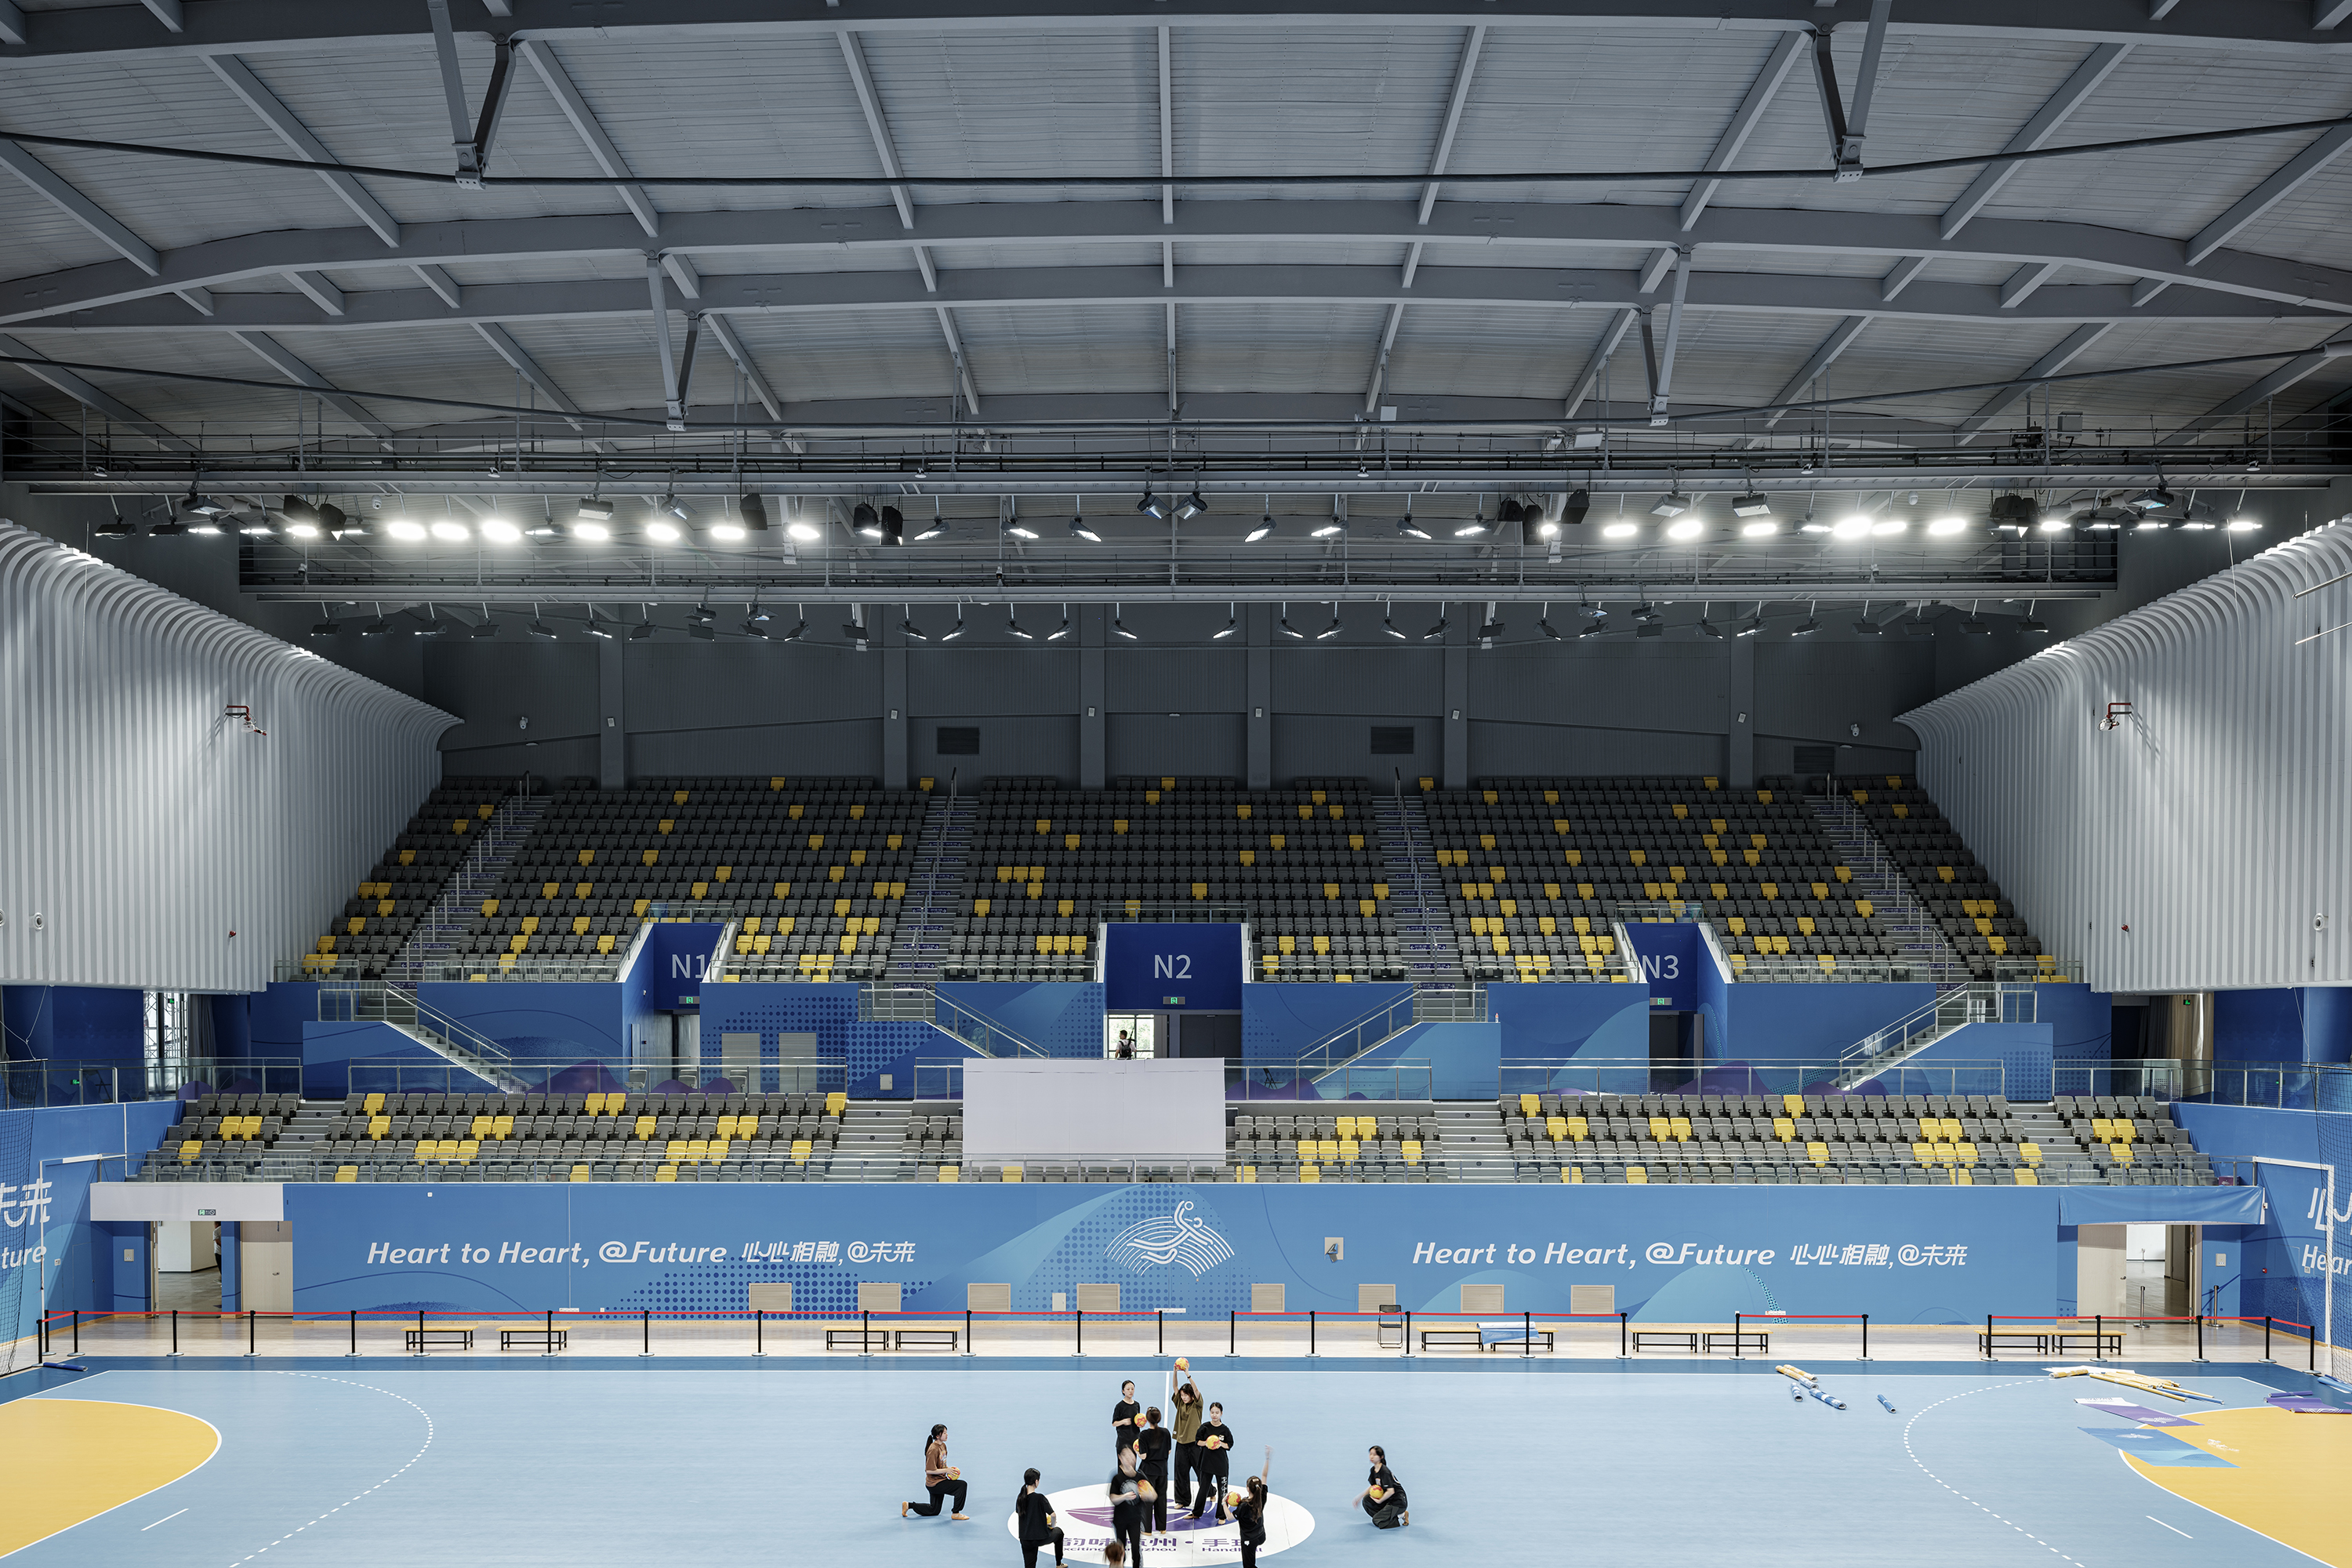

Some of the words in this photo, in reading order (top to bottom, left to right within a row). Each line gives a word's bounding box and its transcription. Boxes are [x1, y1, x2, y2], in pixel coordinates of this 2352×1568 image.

[672, 953, 706, 978] N1
[1154, 954, 1192, 979] N2
[1642, 954, 1679, 980] N3
[0, 1245, 47, 1269] ture
[366, 1242, 452, 1265] Heart
[461, 1243, 491, 1264] to
[498, 1241, 590, 1269] Heart,
[598, 1240, 728, 1265] @Future
[1412, 1242, 1497, 1265] Heart
[1507, 1243, 1537, 1265] to
[1543, 1242, 1636, 1270] Heart,
[1645, 1242, 1776, 1266] @Future
